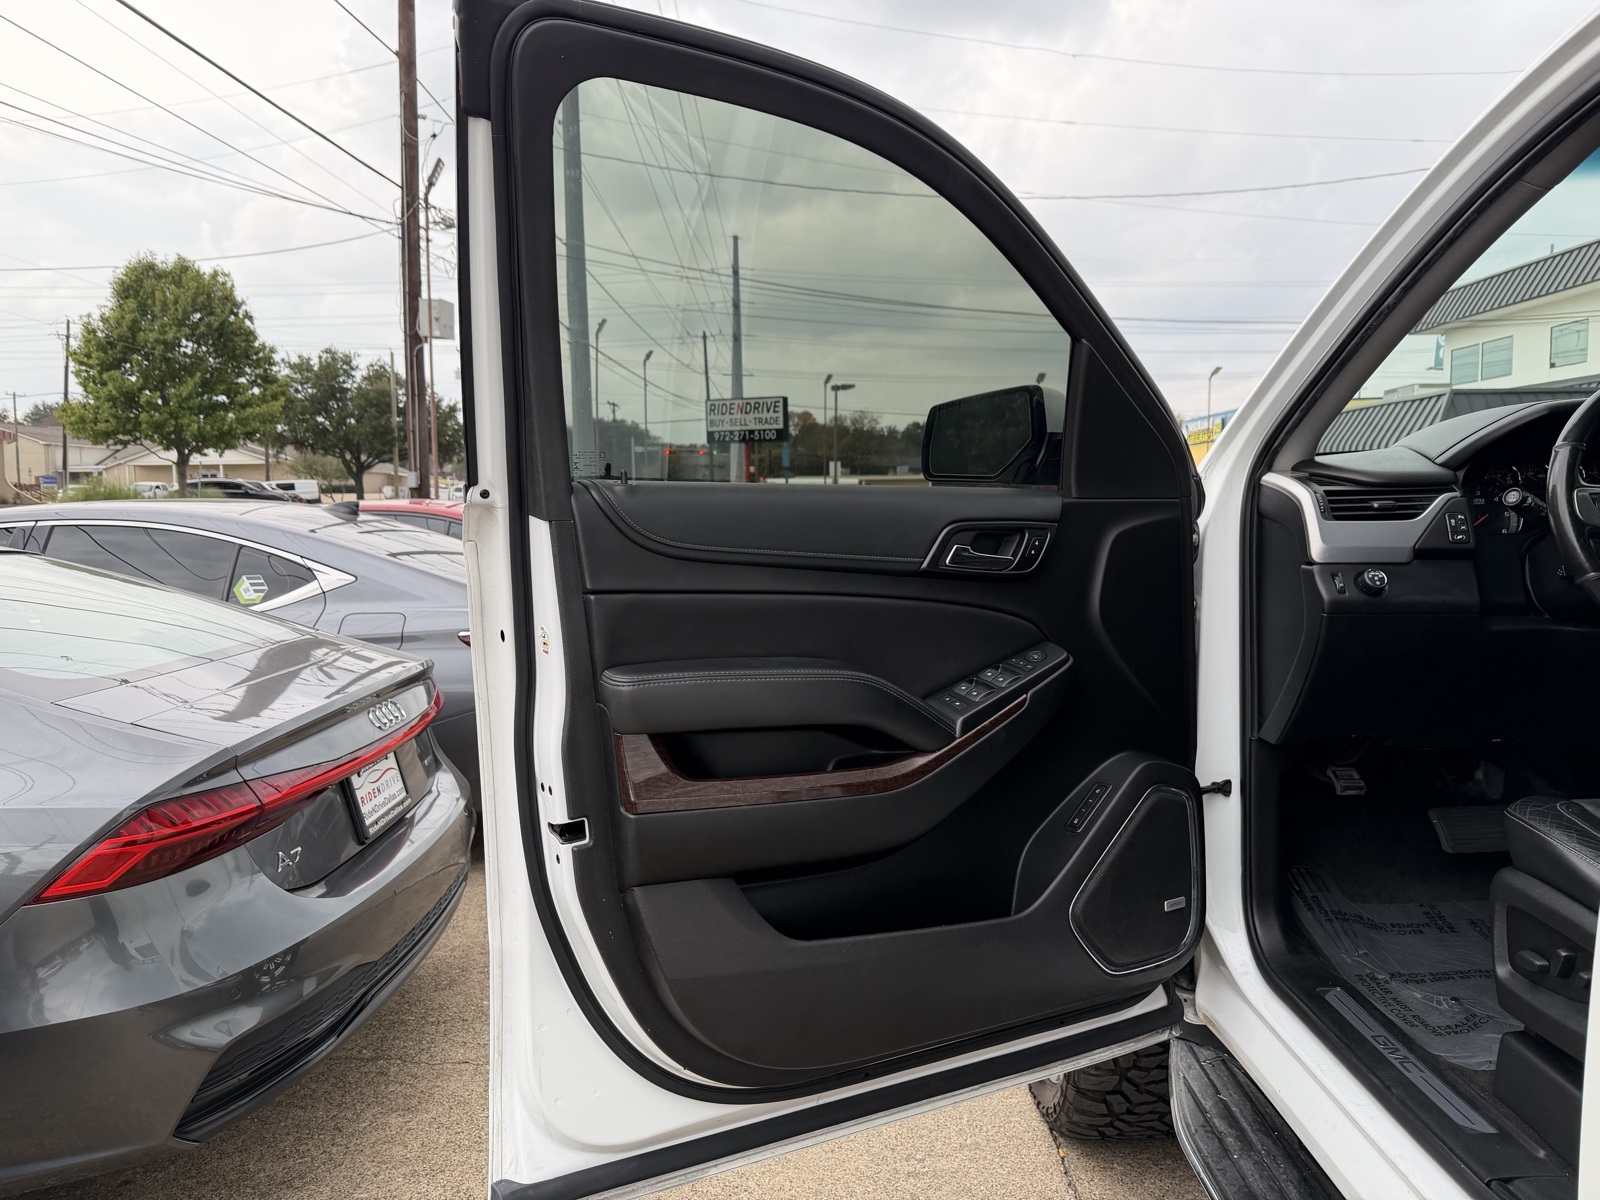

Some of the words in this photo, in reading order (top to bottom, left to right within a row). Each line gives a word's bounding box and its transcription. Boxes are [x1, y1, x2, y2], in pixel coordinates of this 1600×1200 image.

[709, 400, 781, 416] RIDENDRIVE
[713, 430, 777, 441] 972-271-5100
[360, 773, 401, 807] RIDENDRIVE
[277, 846, 302, 873] A7
[1354, 974, 1395, 1008] PROTECTIVE
[1390, 1008, 1419, 1028] COVER
[1365, 971, 1393, 995] DEALER
[1391, 997, 1413, 1012] MUST
[1410, 1013, 1446, 1037] REMOVE
[1437, 1012, 1477, 1030] DEALER
[1370, 1034, 1426, 1073] GMC
